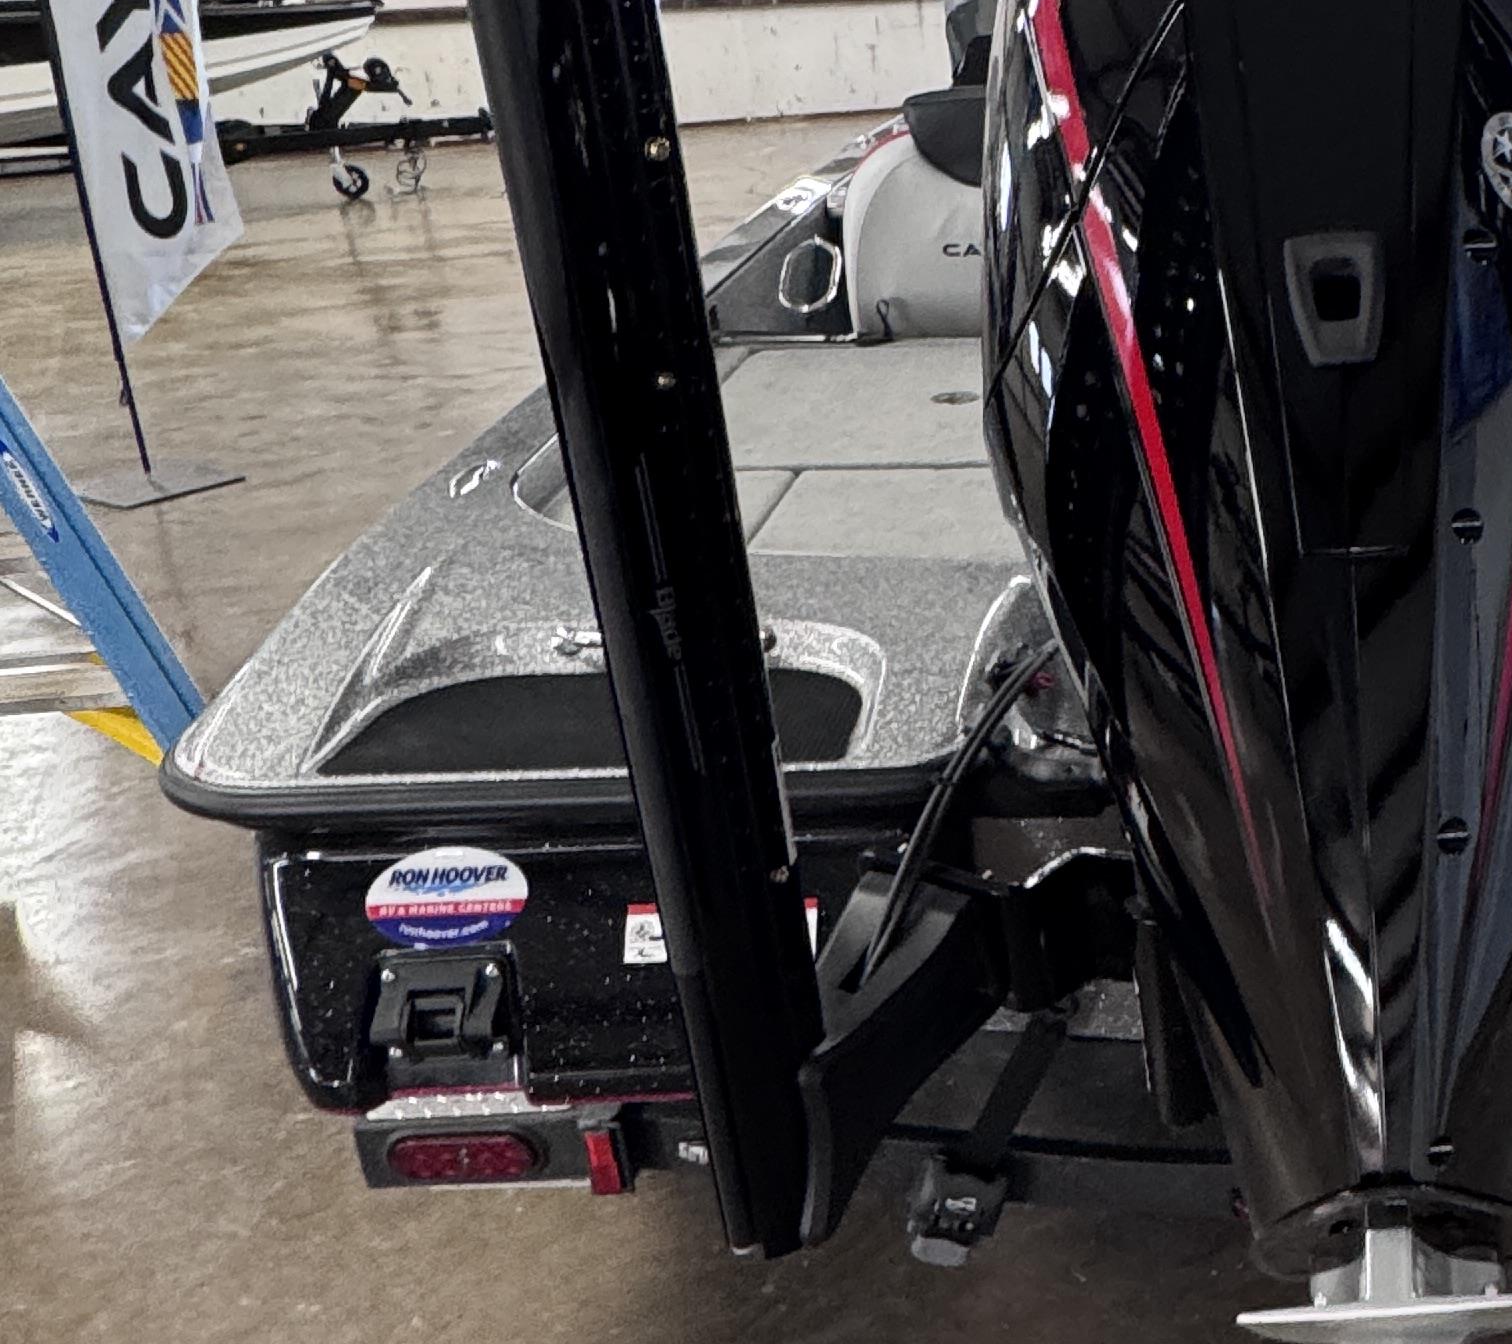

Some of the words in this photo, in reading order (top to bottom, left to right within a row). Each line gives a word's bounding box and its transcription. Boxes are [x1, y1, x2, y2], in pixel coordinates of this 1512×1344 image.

[389, 867, 430, 887] RON
[432, 865, 508, 885] HOOVER
[409, 904, 454, 916] MARINE
